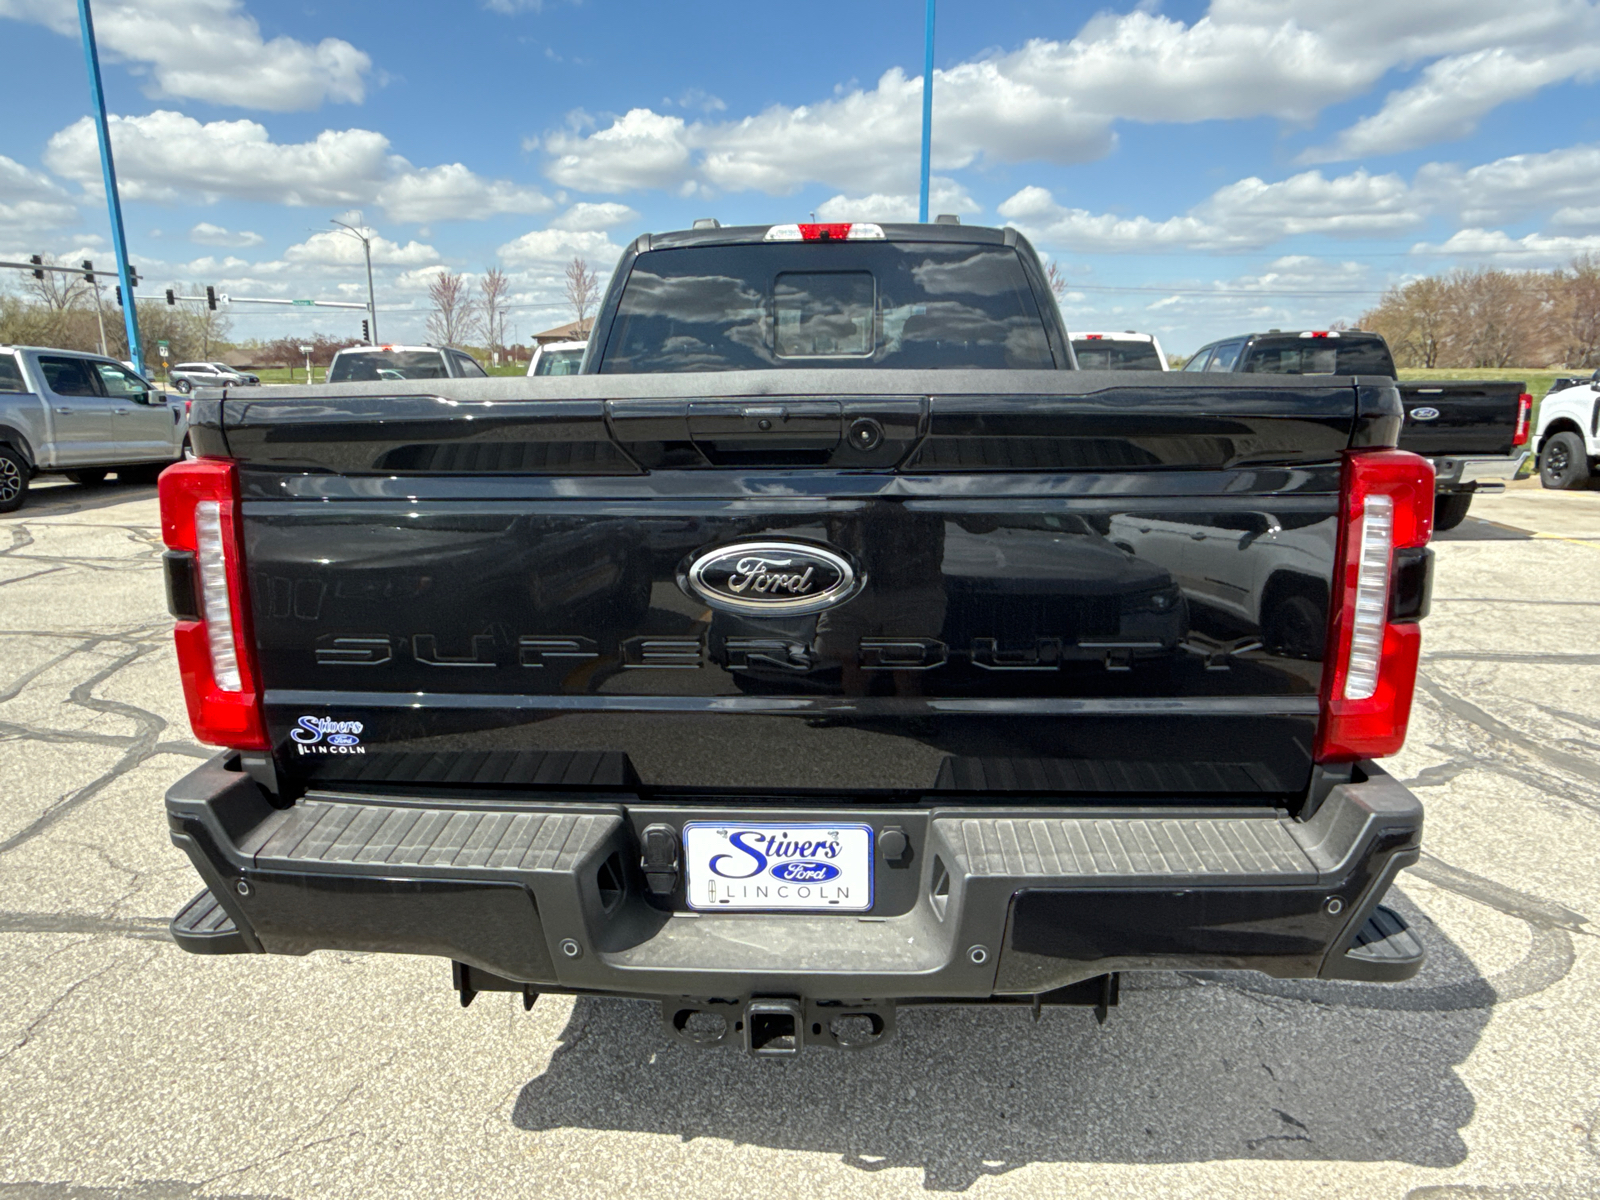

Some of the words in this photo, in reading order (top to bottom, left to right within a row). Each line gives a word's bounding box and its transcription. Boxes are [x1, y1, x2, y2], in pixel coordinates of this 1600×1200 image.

[728, 557, 815, 593] Ford
[314, 633, 809, 671] SUPER
[859, 636, 1264, 672] DUTY
[290, 715, 364, 744] Stivers
[333, 736, 353, 744] Ford
[304, 745, 366, 754] LINCOLN
[709, 830, 843, 879] Stivers
[783, 863, 827, 880] Ford
[726, 885, 850, 899] LINCOLN
